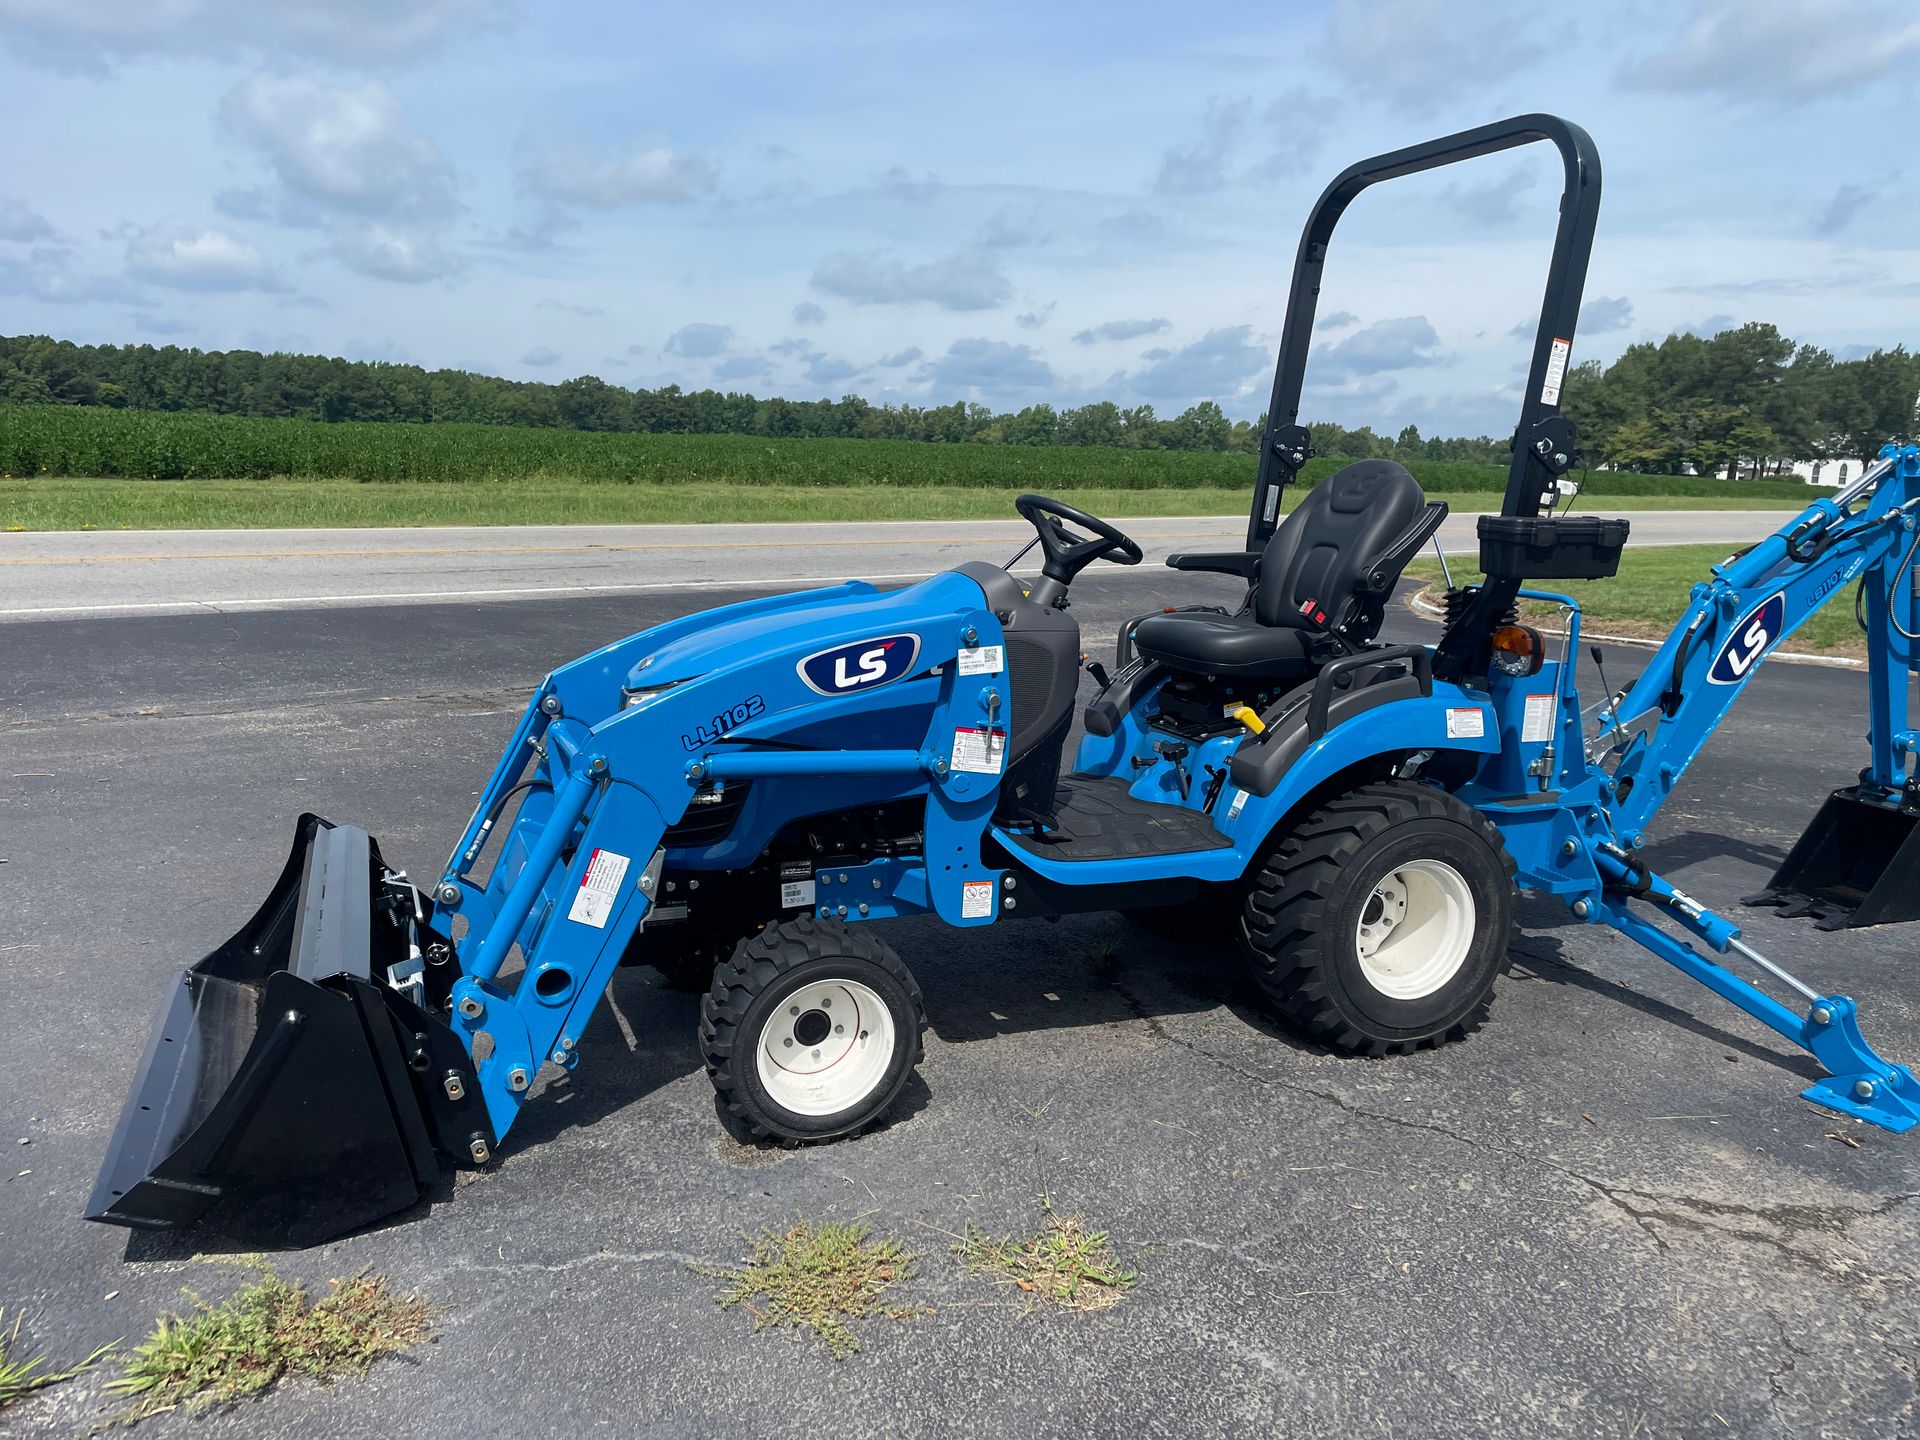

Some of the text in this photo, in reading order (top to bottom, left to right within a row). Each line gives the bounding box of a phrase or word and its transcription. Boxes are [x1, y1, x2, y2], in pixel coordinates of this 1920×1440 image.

[1807, 565, 1846, 608] LB1107
[834, 647, 888, 689] LS
[1727, 619, 1768, 676] LS
[681, 695, 766, 752] LL1102
